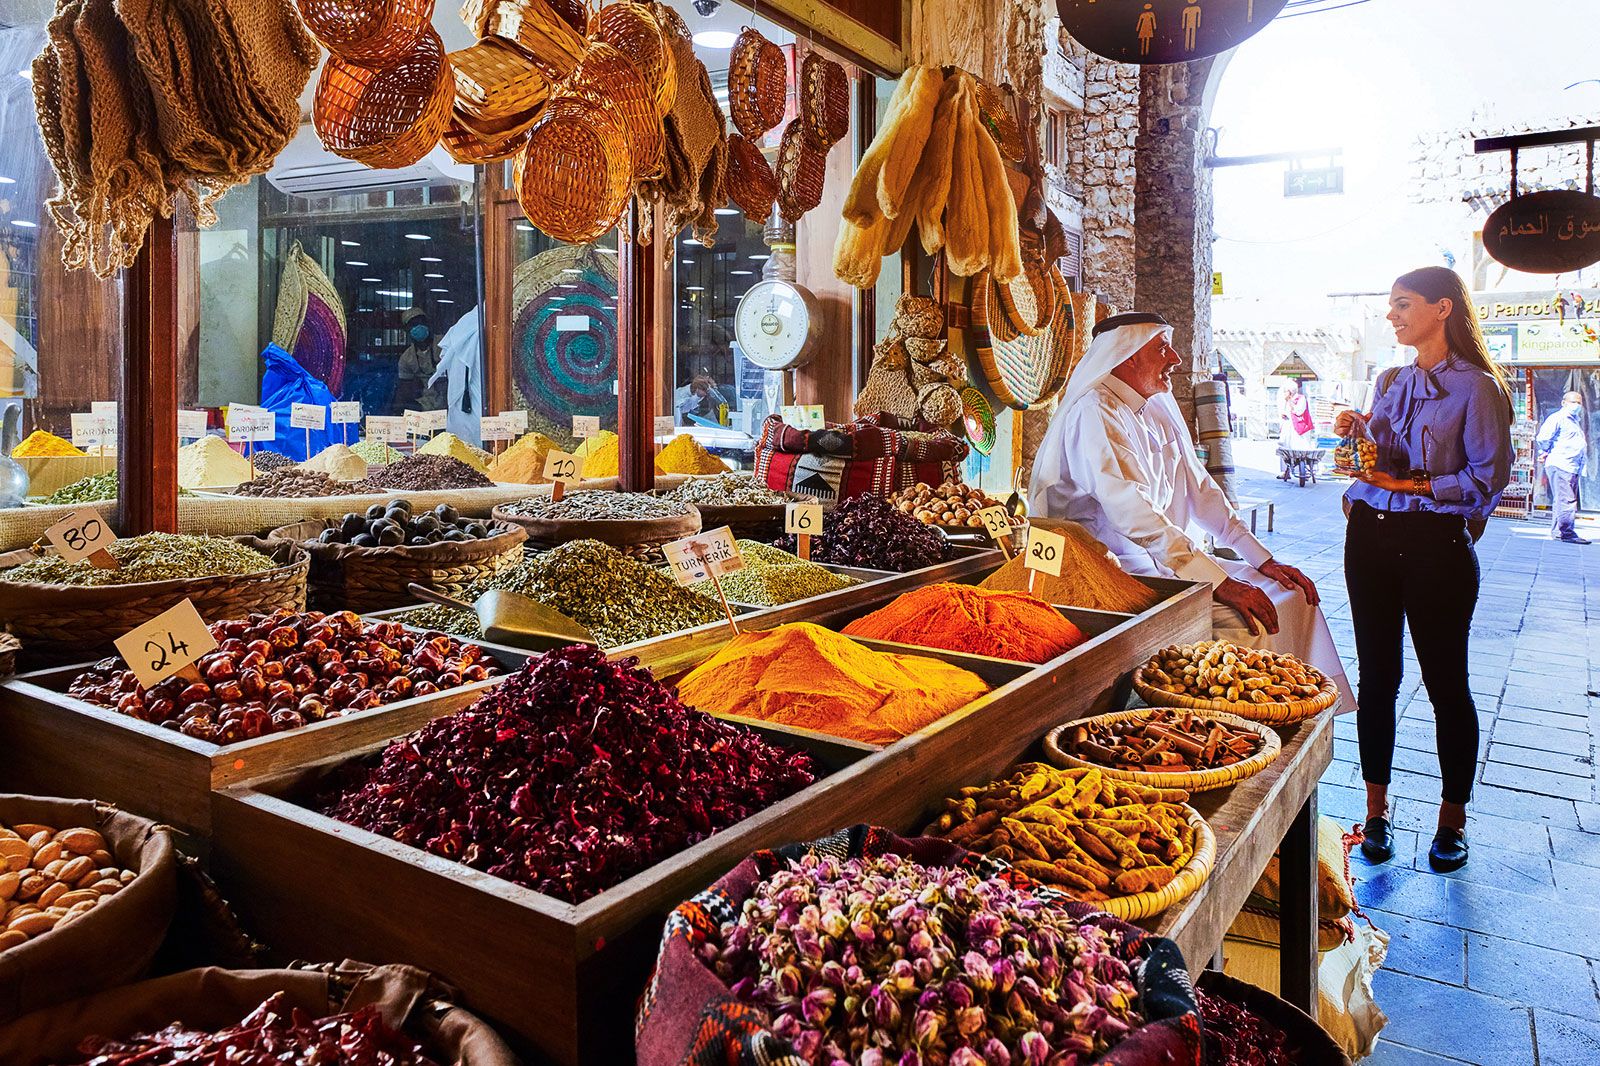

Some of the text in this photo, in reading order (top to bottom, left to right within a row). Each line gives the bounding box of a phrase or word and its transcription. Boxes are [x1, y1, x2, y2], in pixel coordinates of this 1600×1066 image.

[1495, 300, 1551, 318] Parrot
[75, 428, 117, 437] CARDAM
[230, 425, 269, 433] CARDAMOM
[552, 459, 576, 479] 12
[791, 509, 811, 528] 16
[984, 510, 1006, 532] 32
[63, 519, 101, 550] 80
[714, 540, 729, 549] 24
[675, 548, 731, 571] TURMERIK
[1032, 541, 1056, 561] 20
[144, 631, 189, 671] 24
